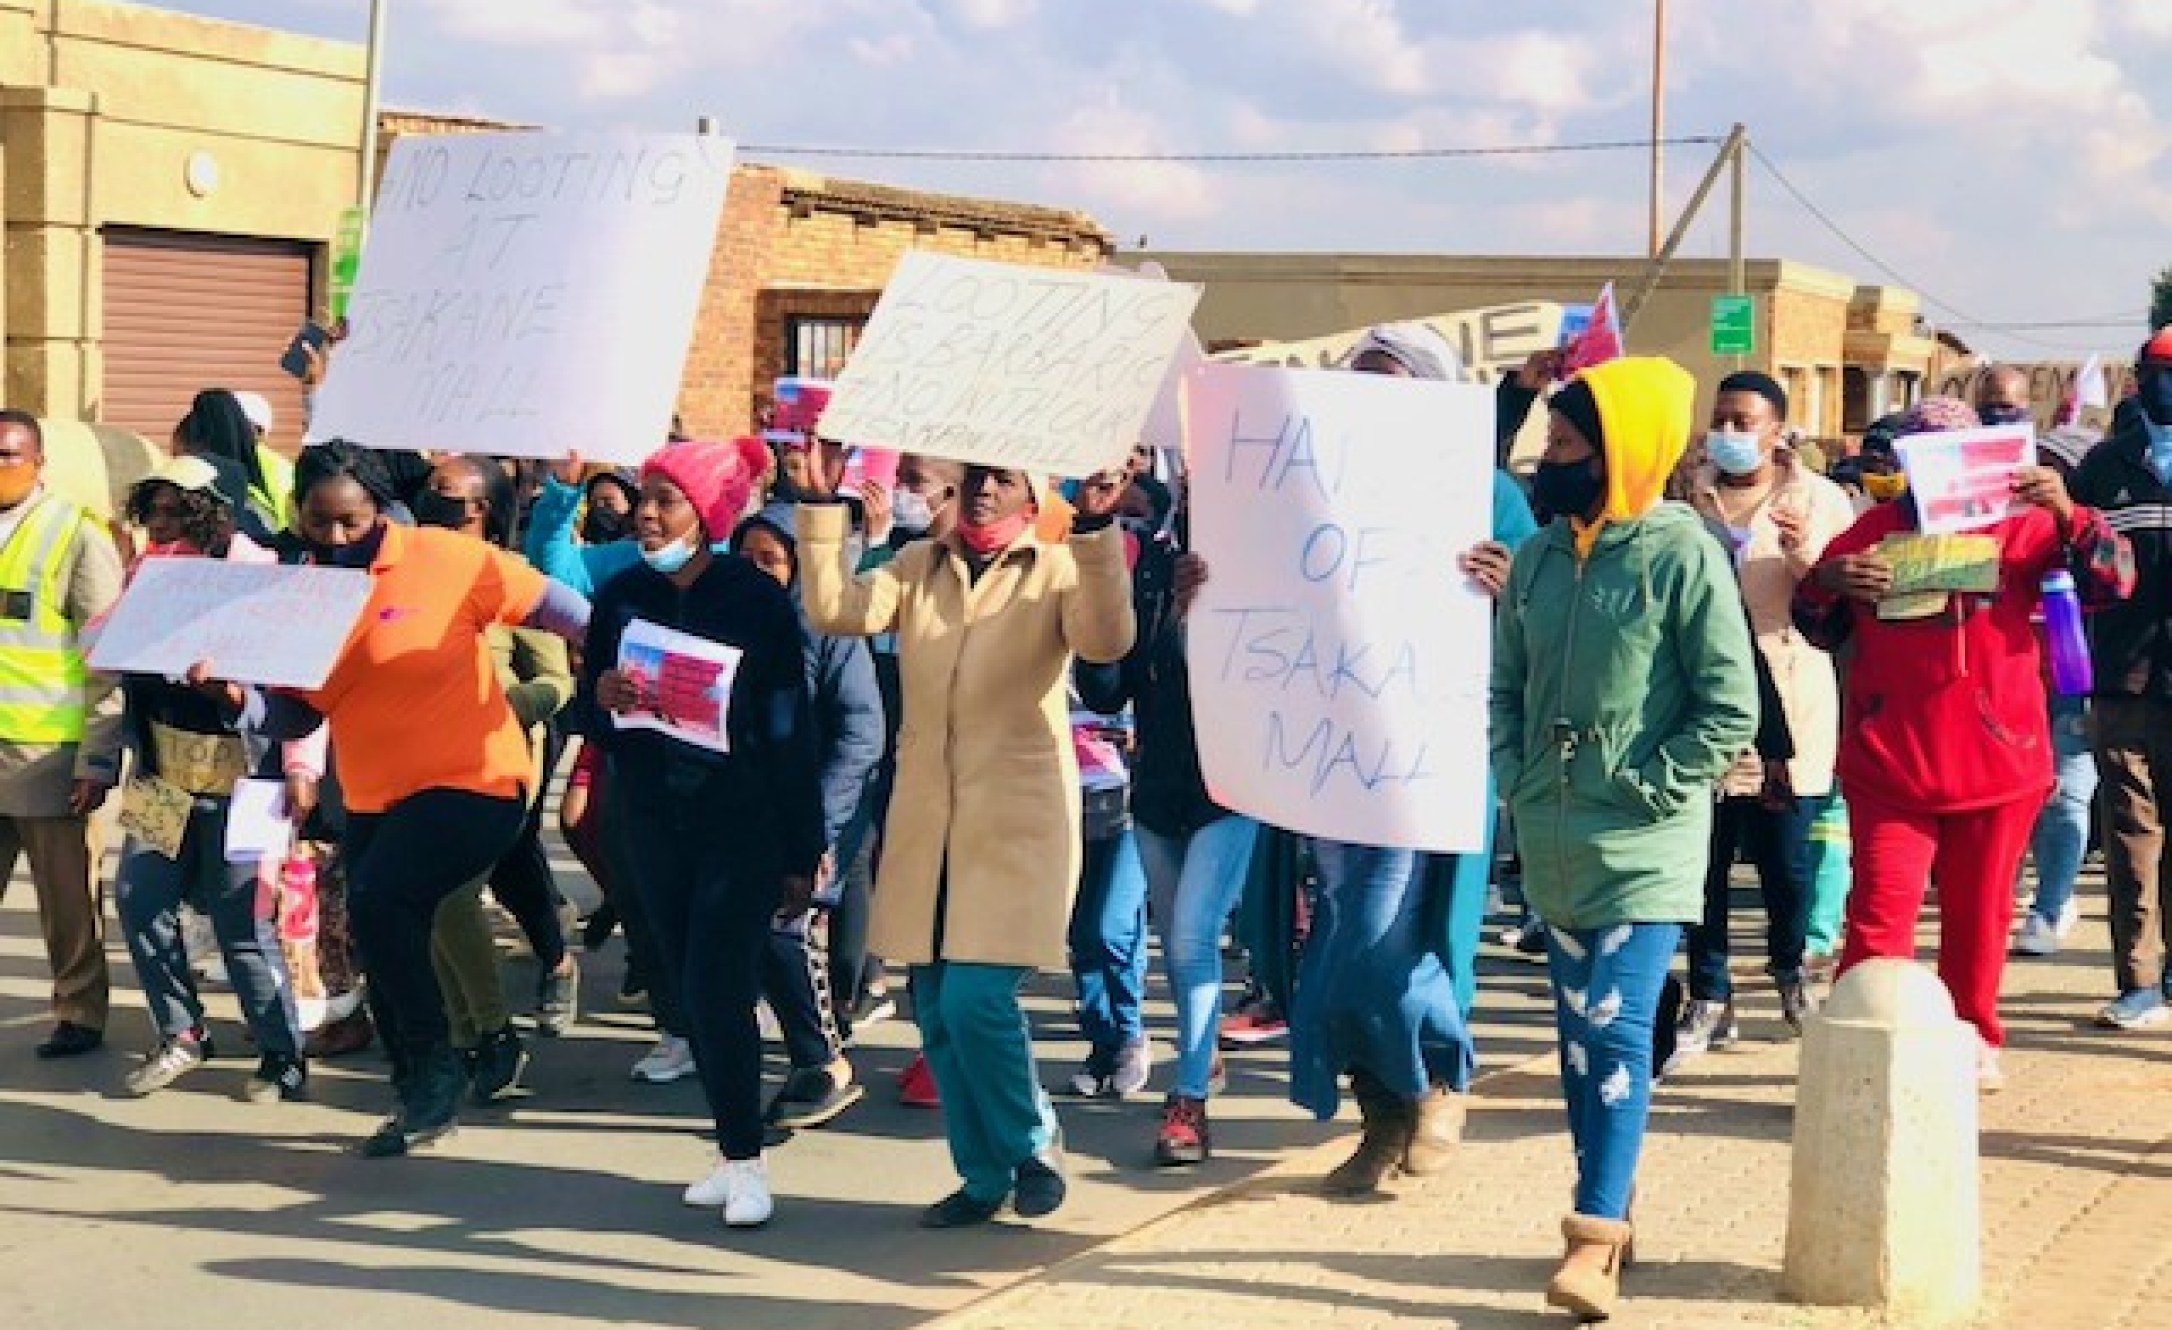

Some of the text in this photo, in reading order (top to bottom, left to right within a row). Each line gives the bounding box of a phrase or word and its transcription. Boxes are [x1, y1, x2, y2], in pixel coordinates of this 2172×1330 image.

[464, 147, 687, 205] LOOTING
[895, 260, 1175, 341] LOOTING
[1301, 523, 1396, 590] OF
[1212, 607, 1422, 700] TSAKA
[1263, 710, 1432, 797] MALL
